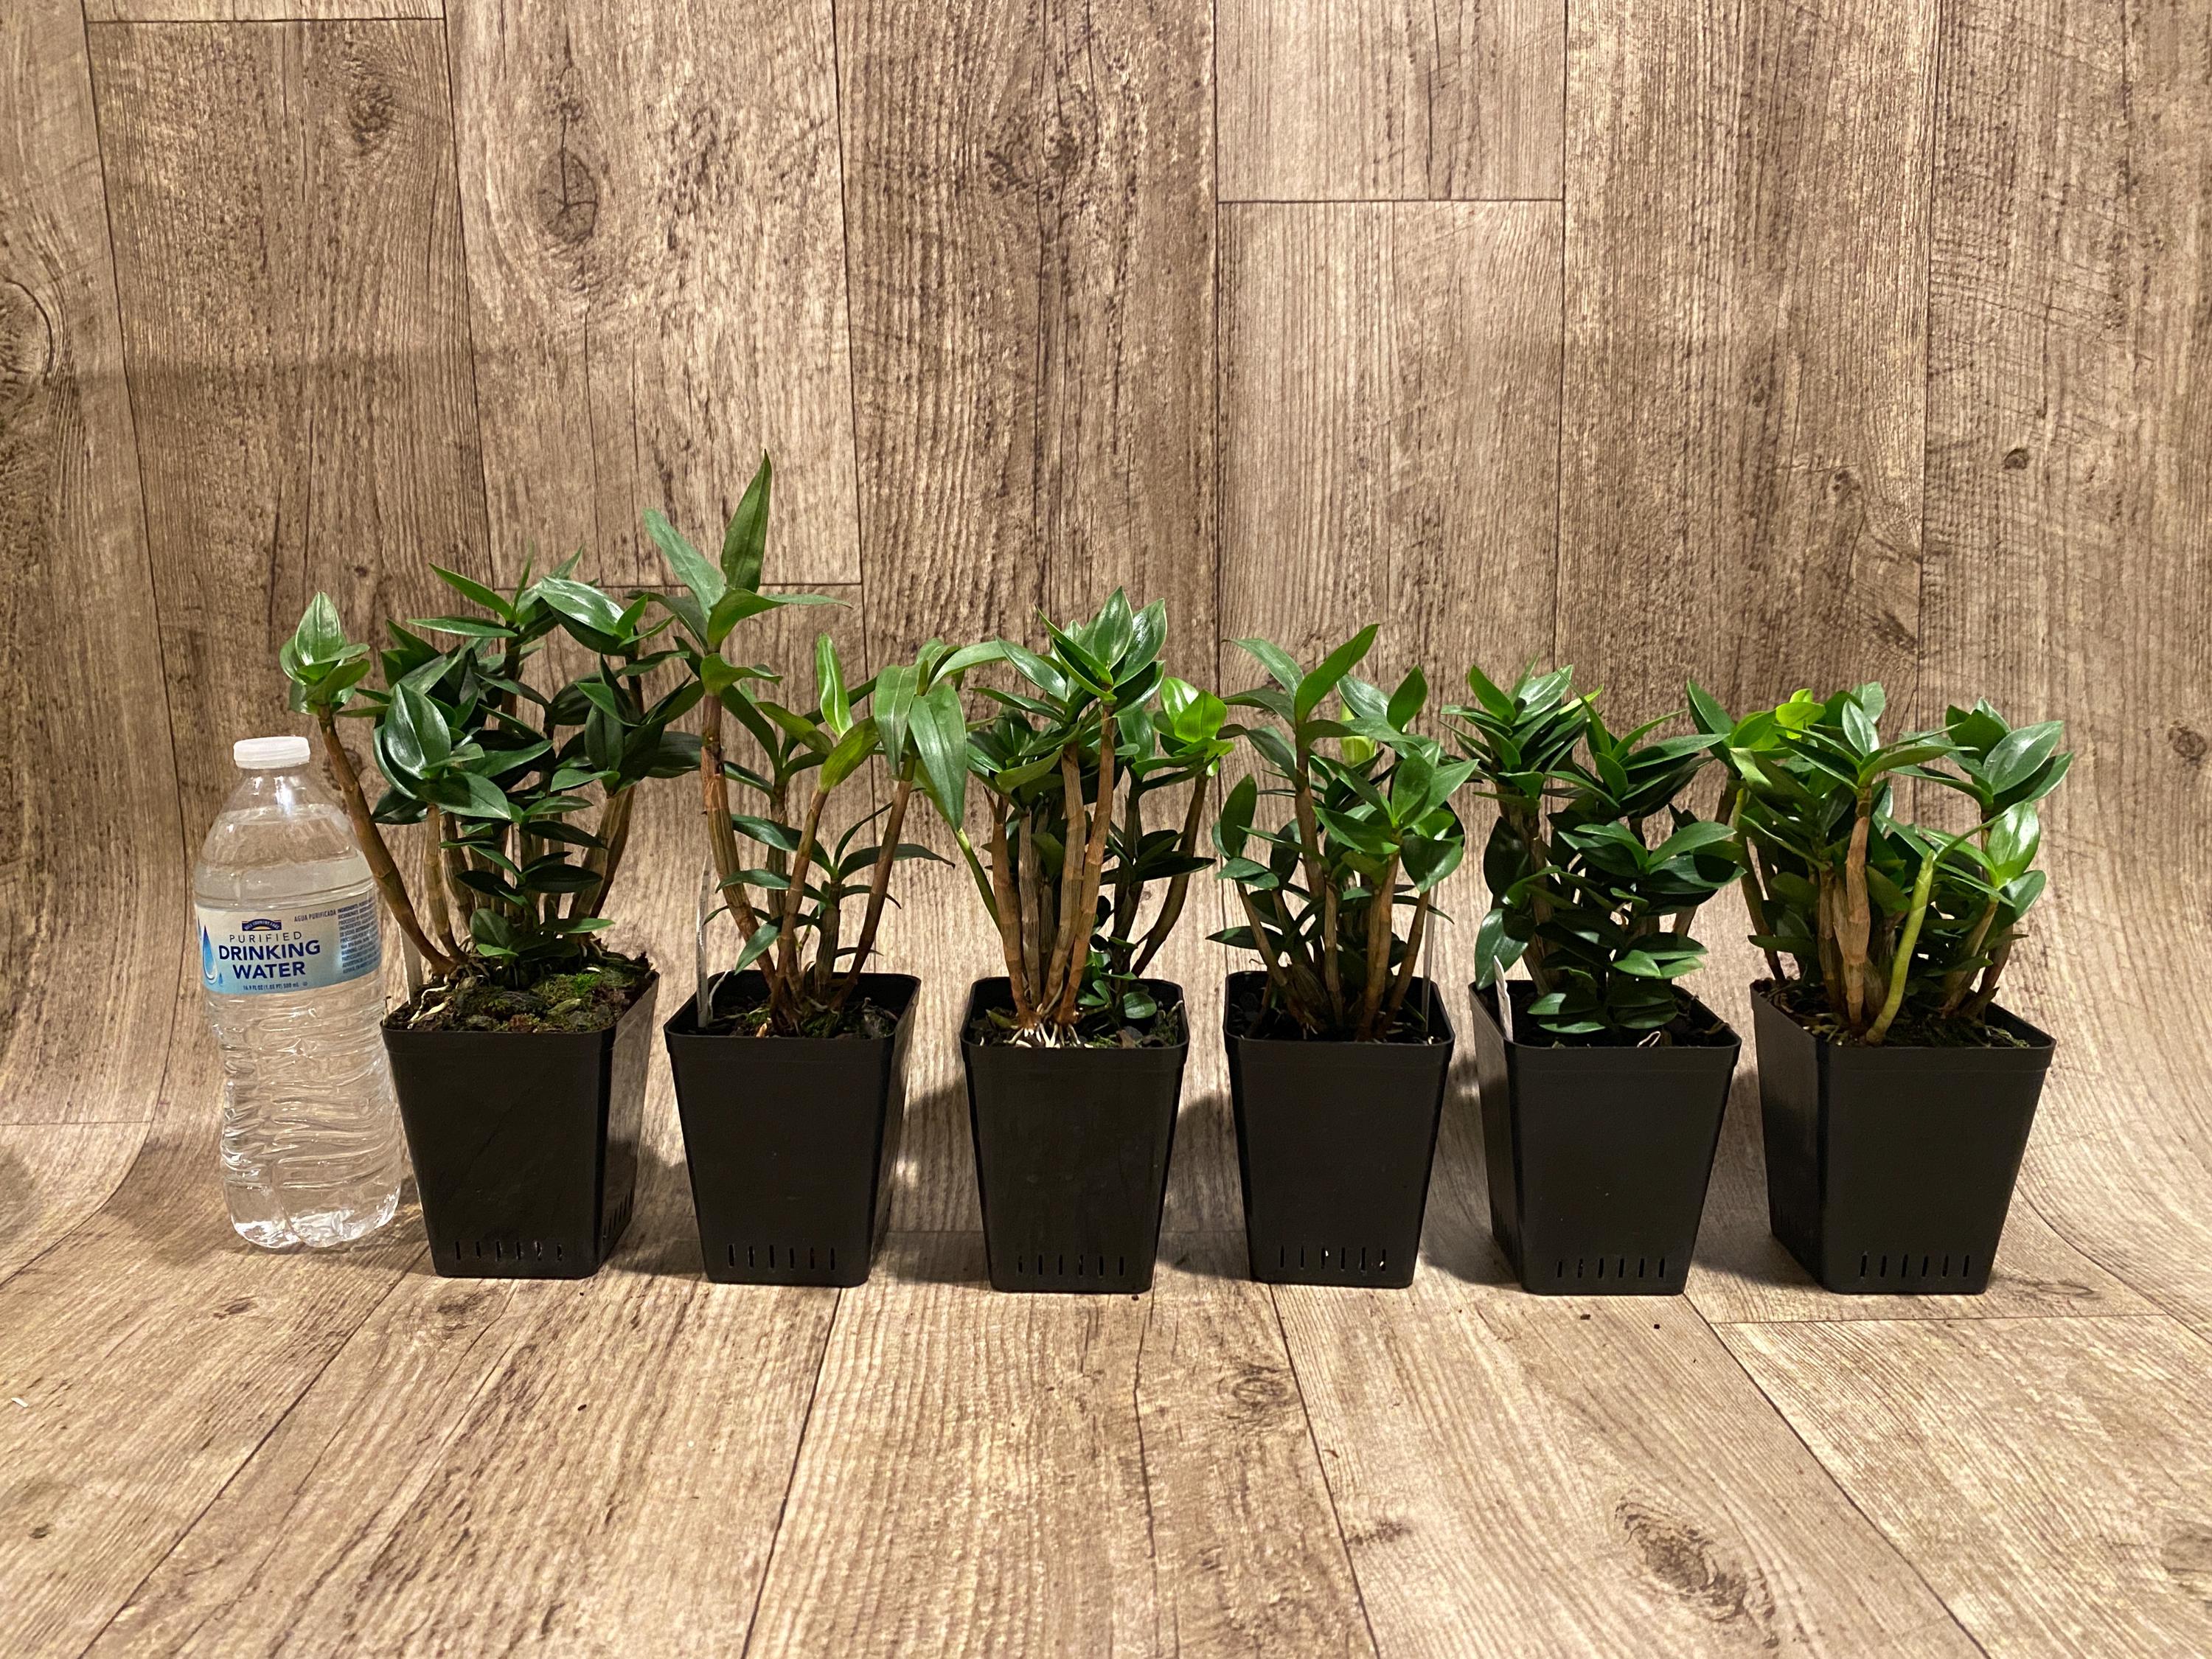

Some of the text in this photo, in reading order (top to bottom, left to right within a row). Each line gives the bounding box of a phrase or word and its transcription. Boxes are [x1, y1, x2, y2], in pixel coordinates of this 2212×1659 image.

[294, 914, 308, 922] AGUA
[308, 909, 337, 920] PURIFICADA
[229, 931, 302, 943] PURIFIED
[219, 939, 321, 961] DRINKING
[232, 961, 306, 979] WATER
